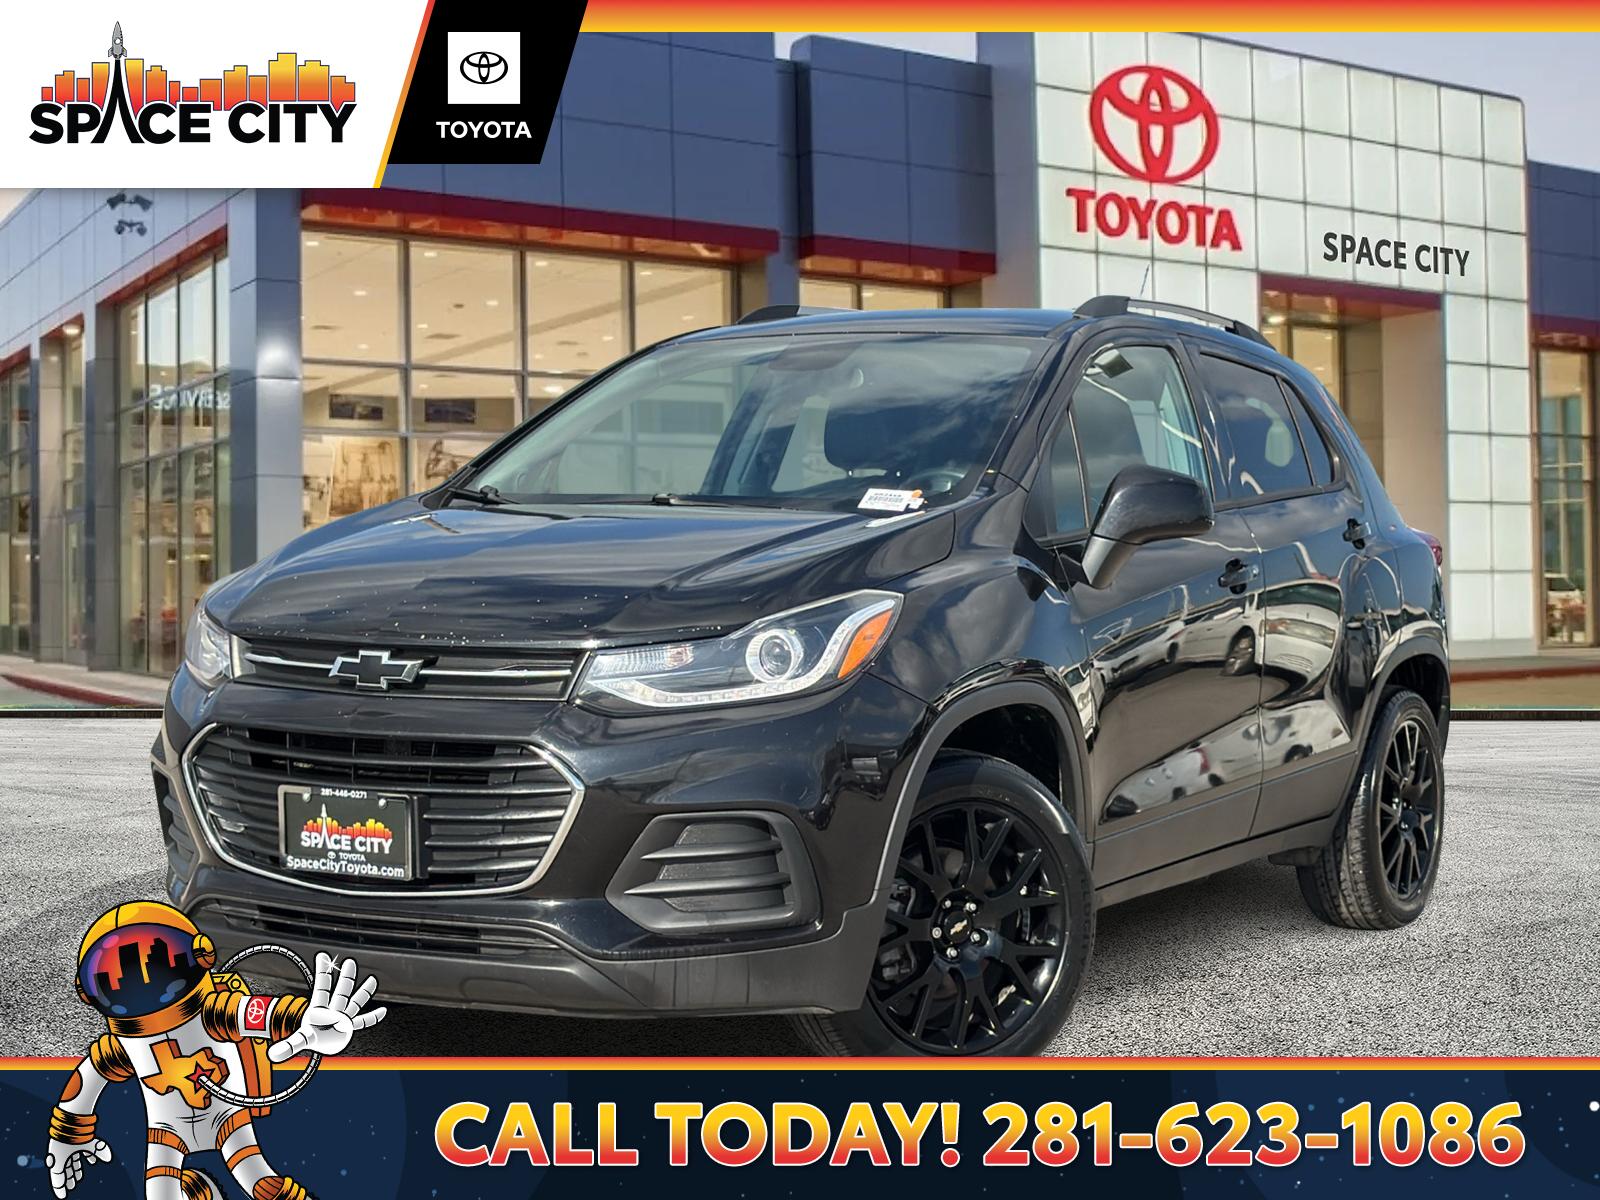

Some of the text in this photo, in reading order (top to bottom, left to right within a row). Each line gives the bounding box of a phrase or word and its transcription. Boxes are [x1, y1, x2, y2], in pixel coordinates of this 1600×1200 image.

[1066, 187, 1242, 251] TOYOTA
[1322, 231, 1470, 277] SPACE CITY
[301, 824, 393, 854] SPACE CITY
[286, 855, 405, 877] SpaceCityToyota.com
[339, 852, 366, 862] TOYOTA
